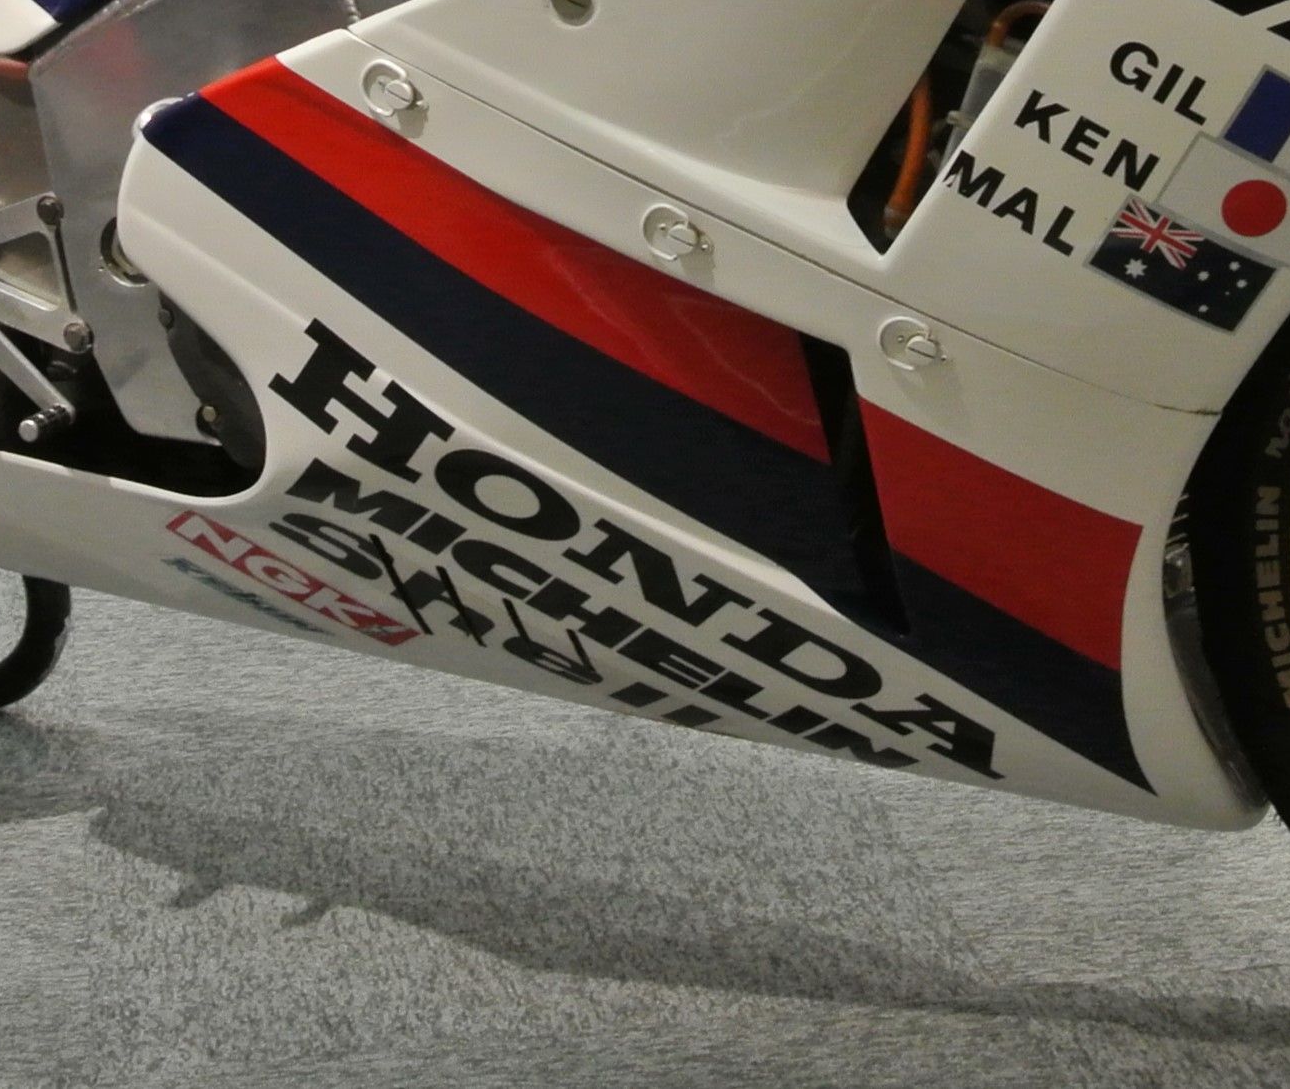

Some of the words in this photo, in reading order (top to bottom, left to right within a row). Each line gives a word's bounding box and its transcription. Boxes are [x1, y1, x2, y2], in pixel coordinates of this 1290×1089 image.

[1109, 41, 1207, 125] GIL
[1014, 90, 1161, 191] KEN
[943, 150, 1076, 256] MAL
[174, 513, 381, 629] NGK
[268, 317, 1005, 780] HONDA
[285, 458, 920, 769] MICHELIN
